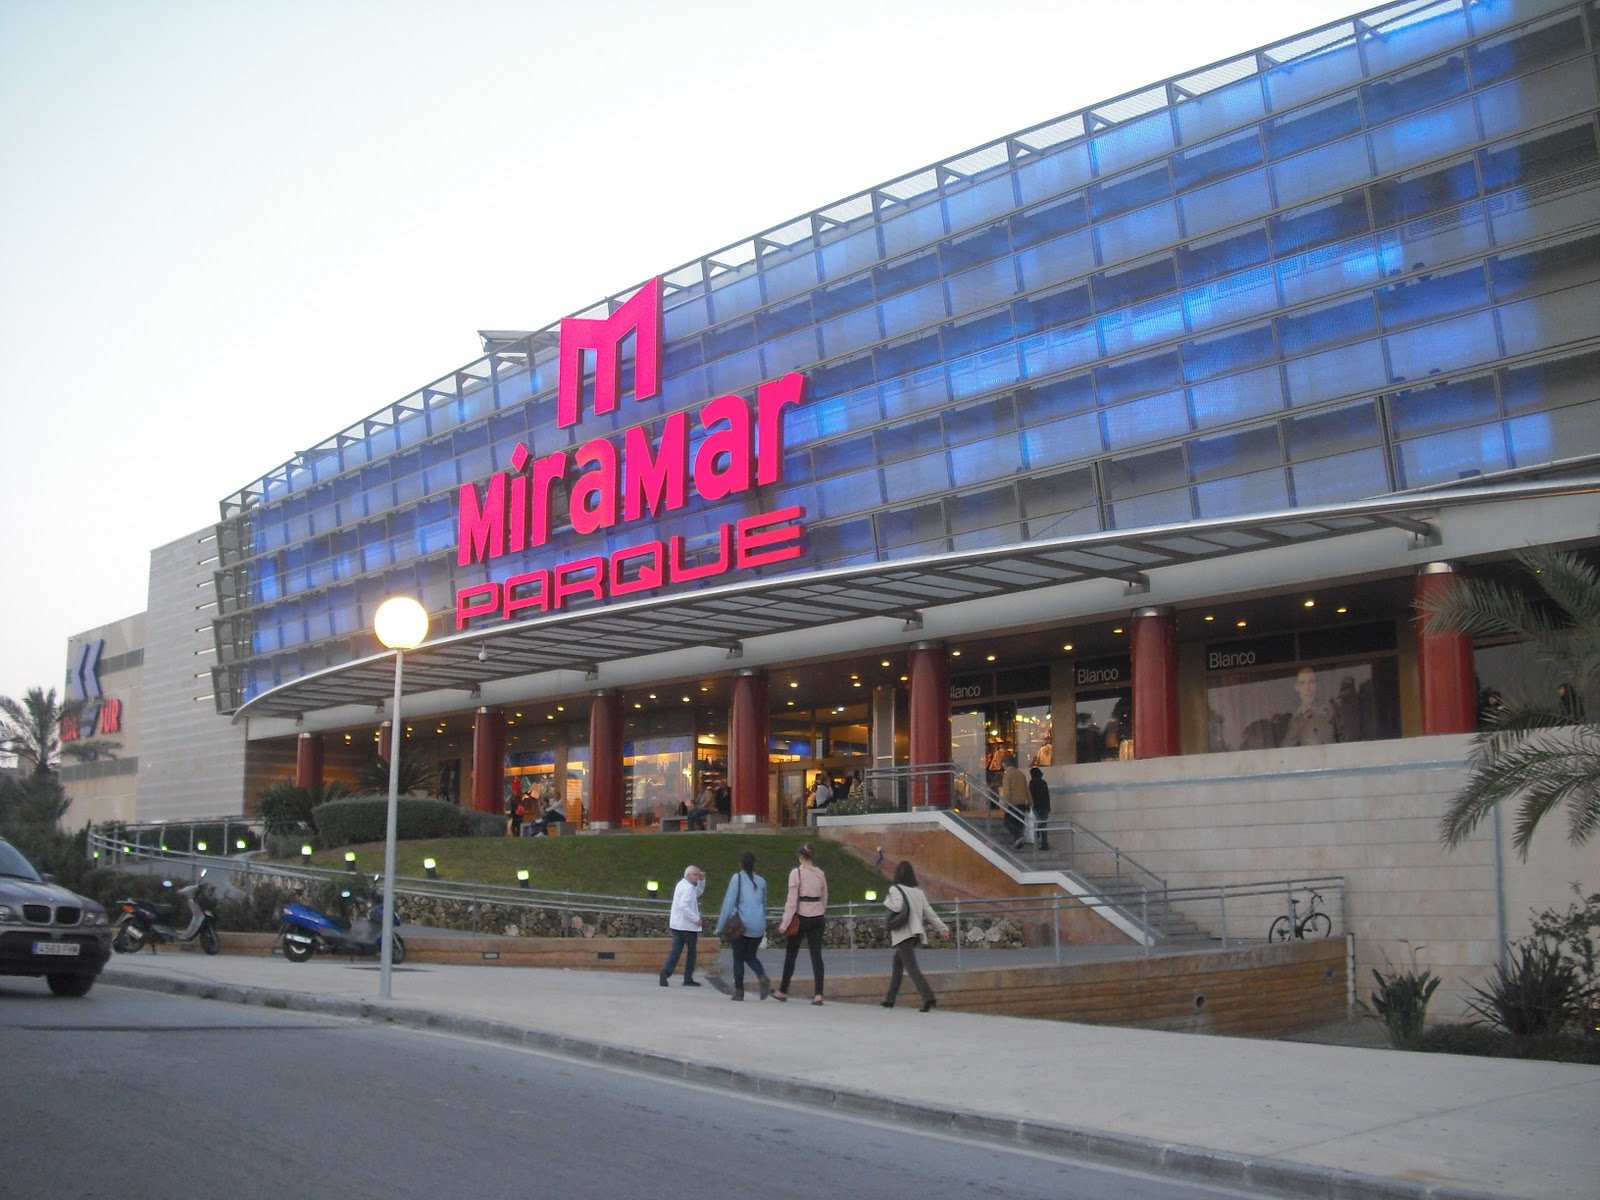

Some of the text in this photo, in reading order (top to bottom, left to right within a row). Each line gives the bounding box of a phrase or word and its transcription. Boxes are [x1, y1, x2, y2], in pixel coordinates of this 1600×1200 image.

[455, 505, 806, 630] PARQUE
[1209, 651, 1255, 669] Blanco
[1077, 667, 1119, 684] Blanco
[950, 684, 981, 699] lanco
